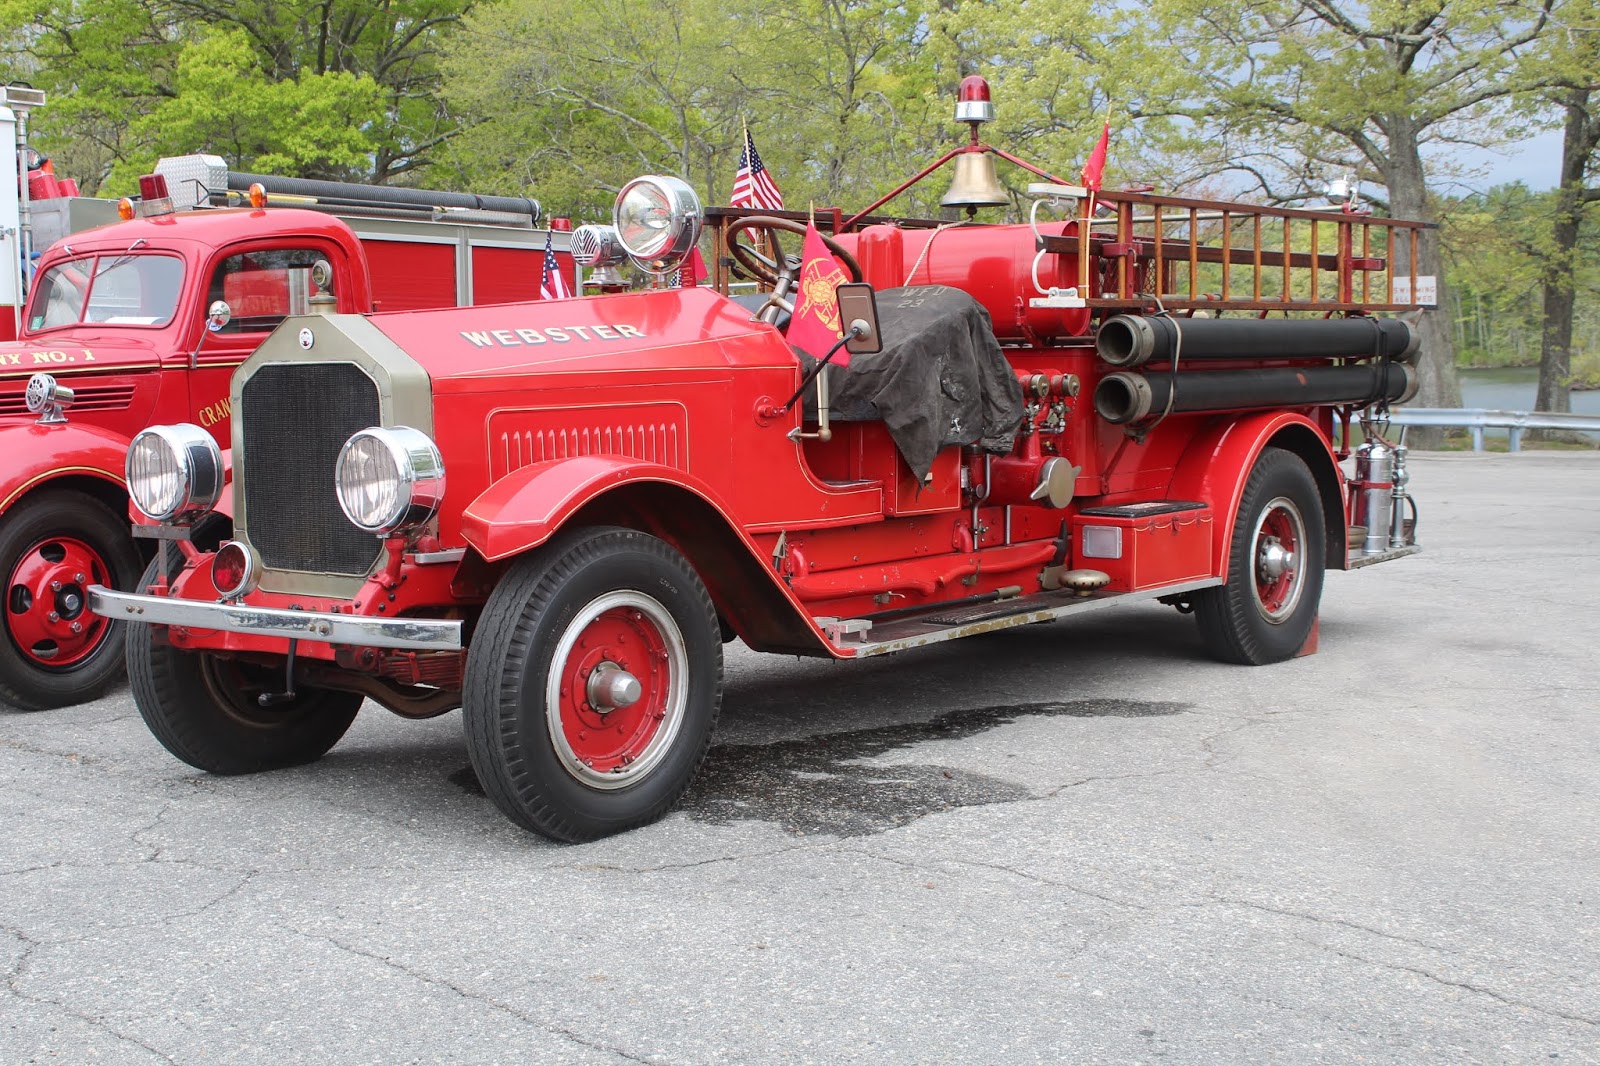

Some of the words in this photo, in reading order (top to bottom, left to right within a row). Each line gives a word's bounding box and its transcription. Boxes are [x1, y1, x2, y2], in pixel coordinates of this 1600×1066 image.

[900, 286, 948, 298] WFD
[1393, 286, 1436, 294] SWIMING
[897, 298, 926, 309] 23
[460, 324, 647, 348] WEBSTER
[31, 350, 75, 364] NO.
[81, 349, 96, 361] 1
